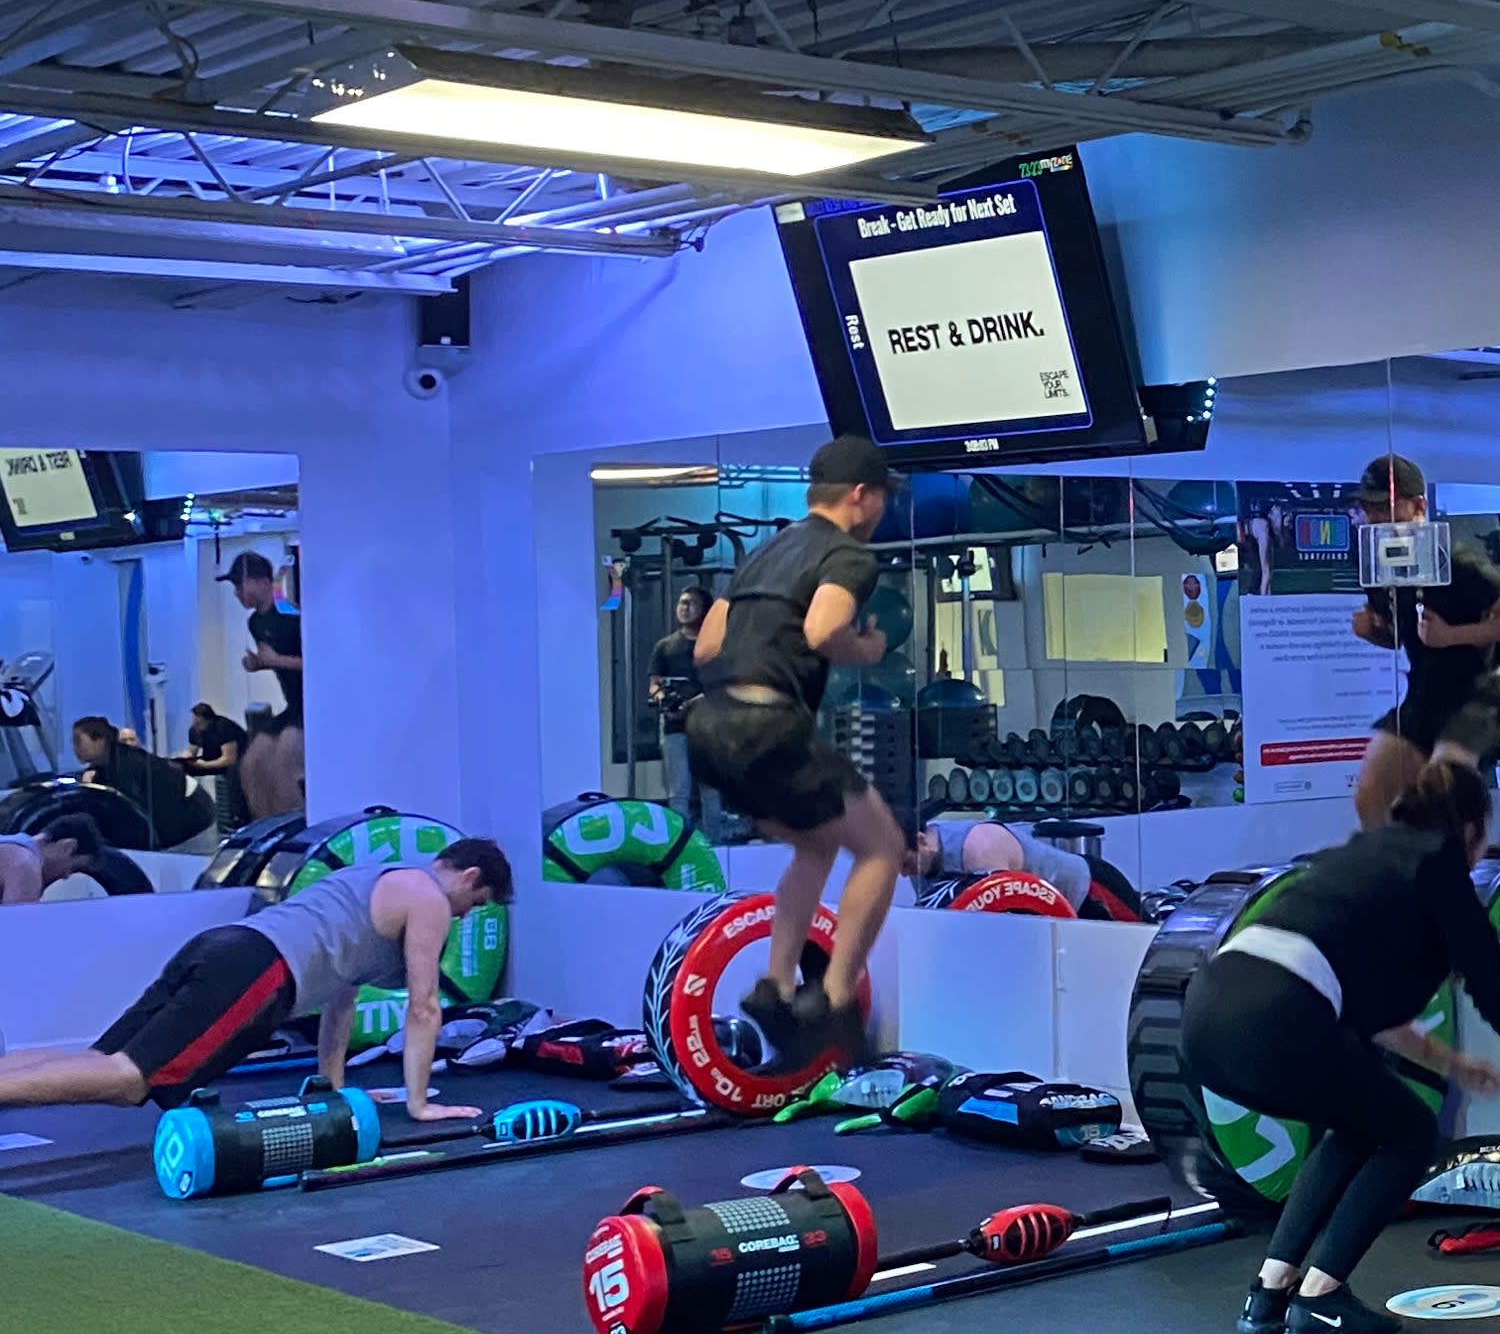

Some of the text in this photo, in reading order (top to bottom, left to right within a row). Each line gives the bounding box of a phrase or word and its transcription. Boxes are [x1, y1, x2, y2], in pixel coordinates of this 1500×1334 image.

[857, 215, 891, 239] Break
[896, 211, 918, 232] Get
[917, 204, 951, 228] Ready
[950, 201, 968, 224] for
[967, 197, 995, 220] Next
[994, 193, 1017, 216] Set
[845, 314, 865, 350] Rest
[887, 310, 1046, 355] REST & DRINK.
[722, 905, 777, 940] ESCAP
[588, 1258, 631, 1313] 15
